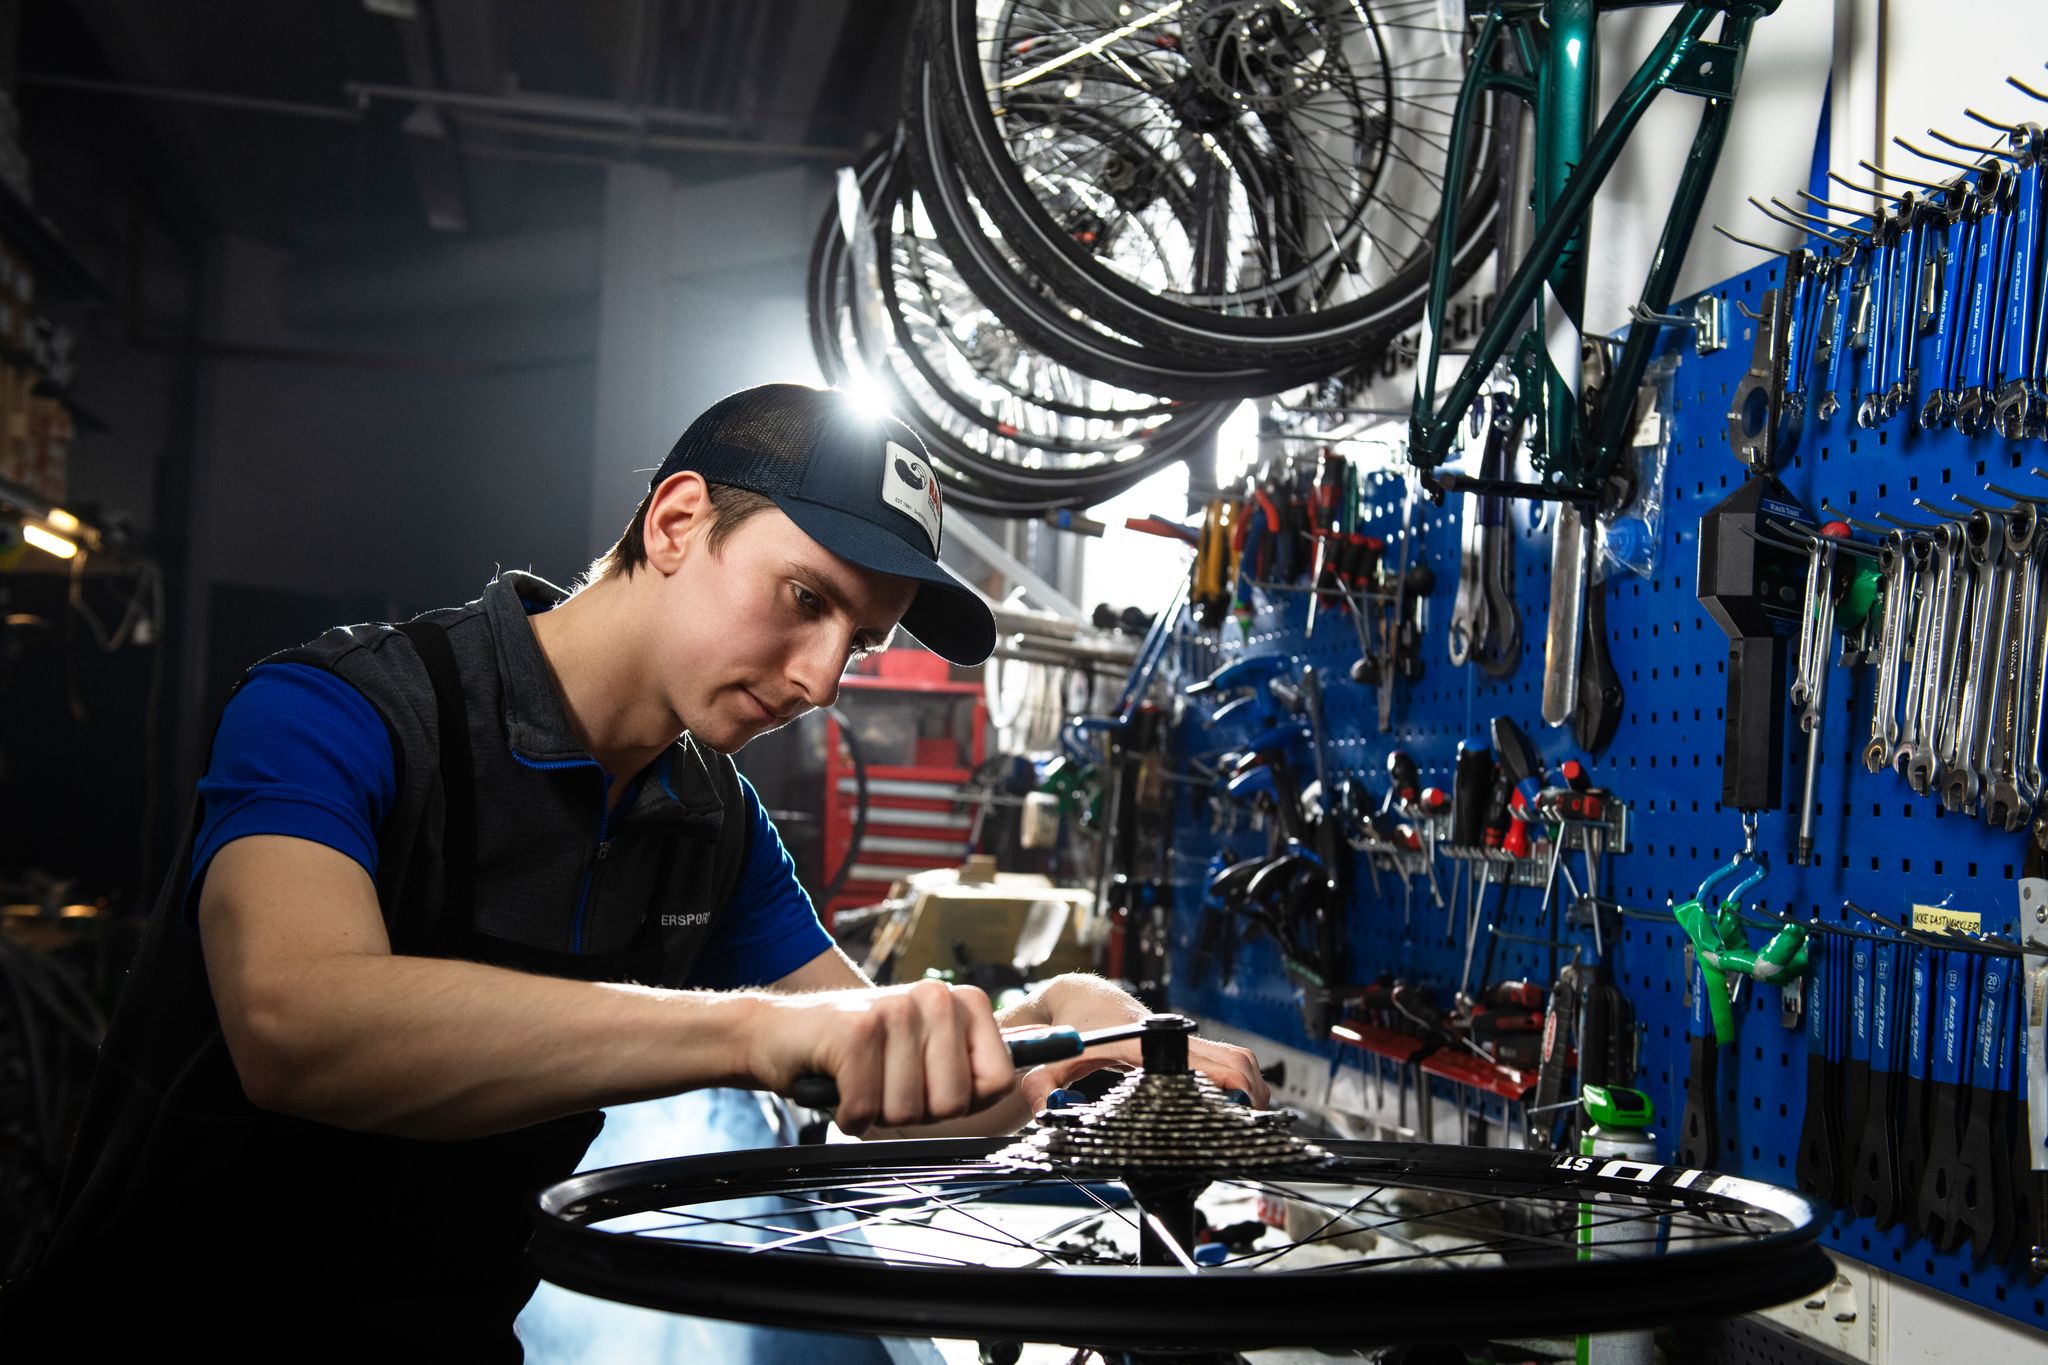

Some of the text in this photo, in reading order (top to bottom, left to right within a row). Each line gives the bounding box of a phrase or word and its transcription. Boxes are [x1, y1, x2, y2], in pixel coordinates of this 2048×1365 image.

[1946, 995, 1957, 1064] Park Tool
[1983, 998, 1995, 1068] Park Tool
[1556, 1156, 1593, 1171] ST
